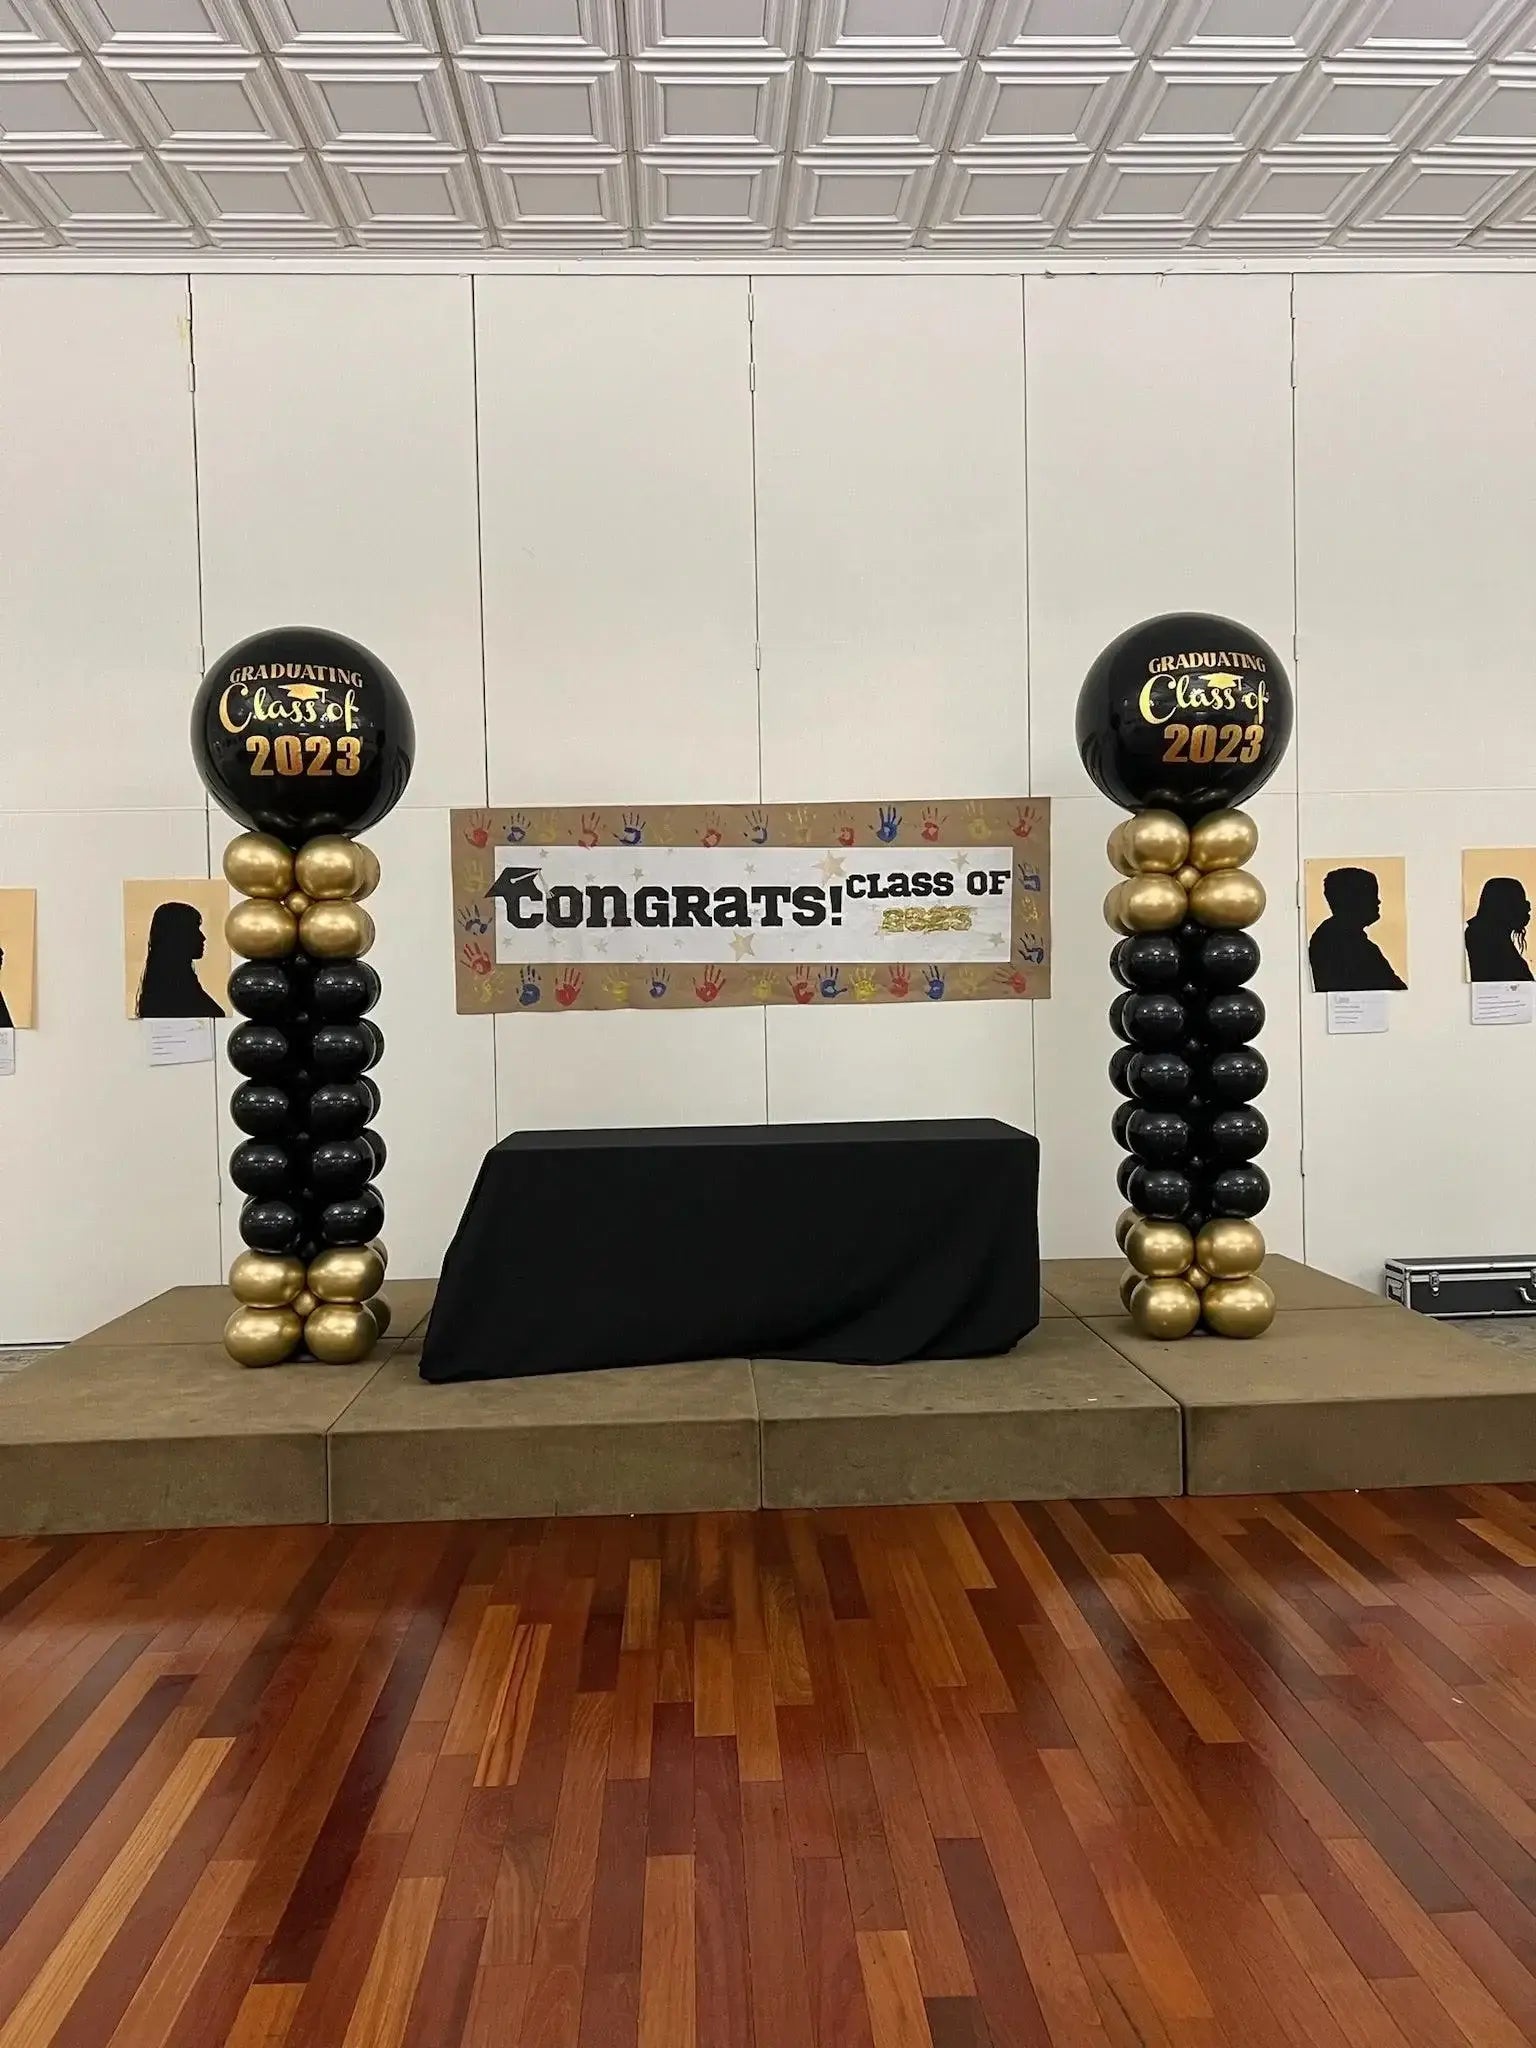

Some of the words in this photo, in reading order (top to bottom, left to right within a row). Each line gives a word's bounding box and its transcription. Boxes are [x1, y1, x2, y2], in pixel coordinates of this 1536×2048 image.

[229, 662, 363, 688] GRADUATING
[1148, 651, 1267, 673] GRADUATING
[218, 682, 318, 734] Class
[320, 689, 360, 733] of
[1138, 673, 1237, 725] Class
[1241, 680, 1270, 725] of
[245, 735, 361, 776] 2023
[1162, 723, 1264, 764] 2023
[966, 870, 1011, 896] OF
